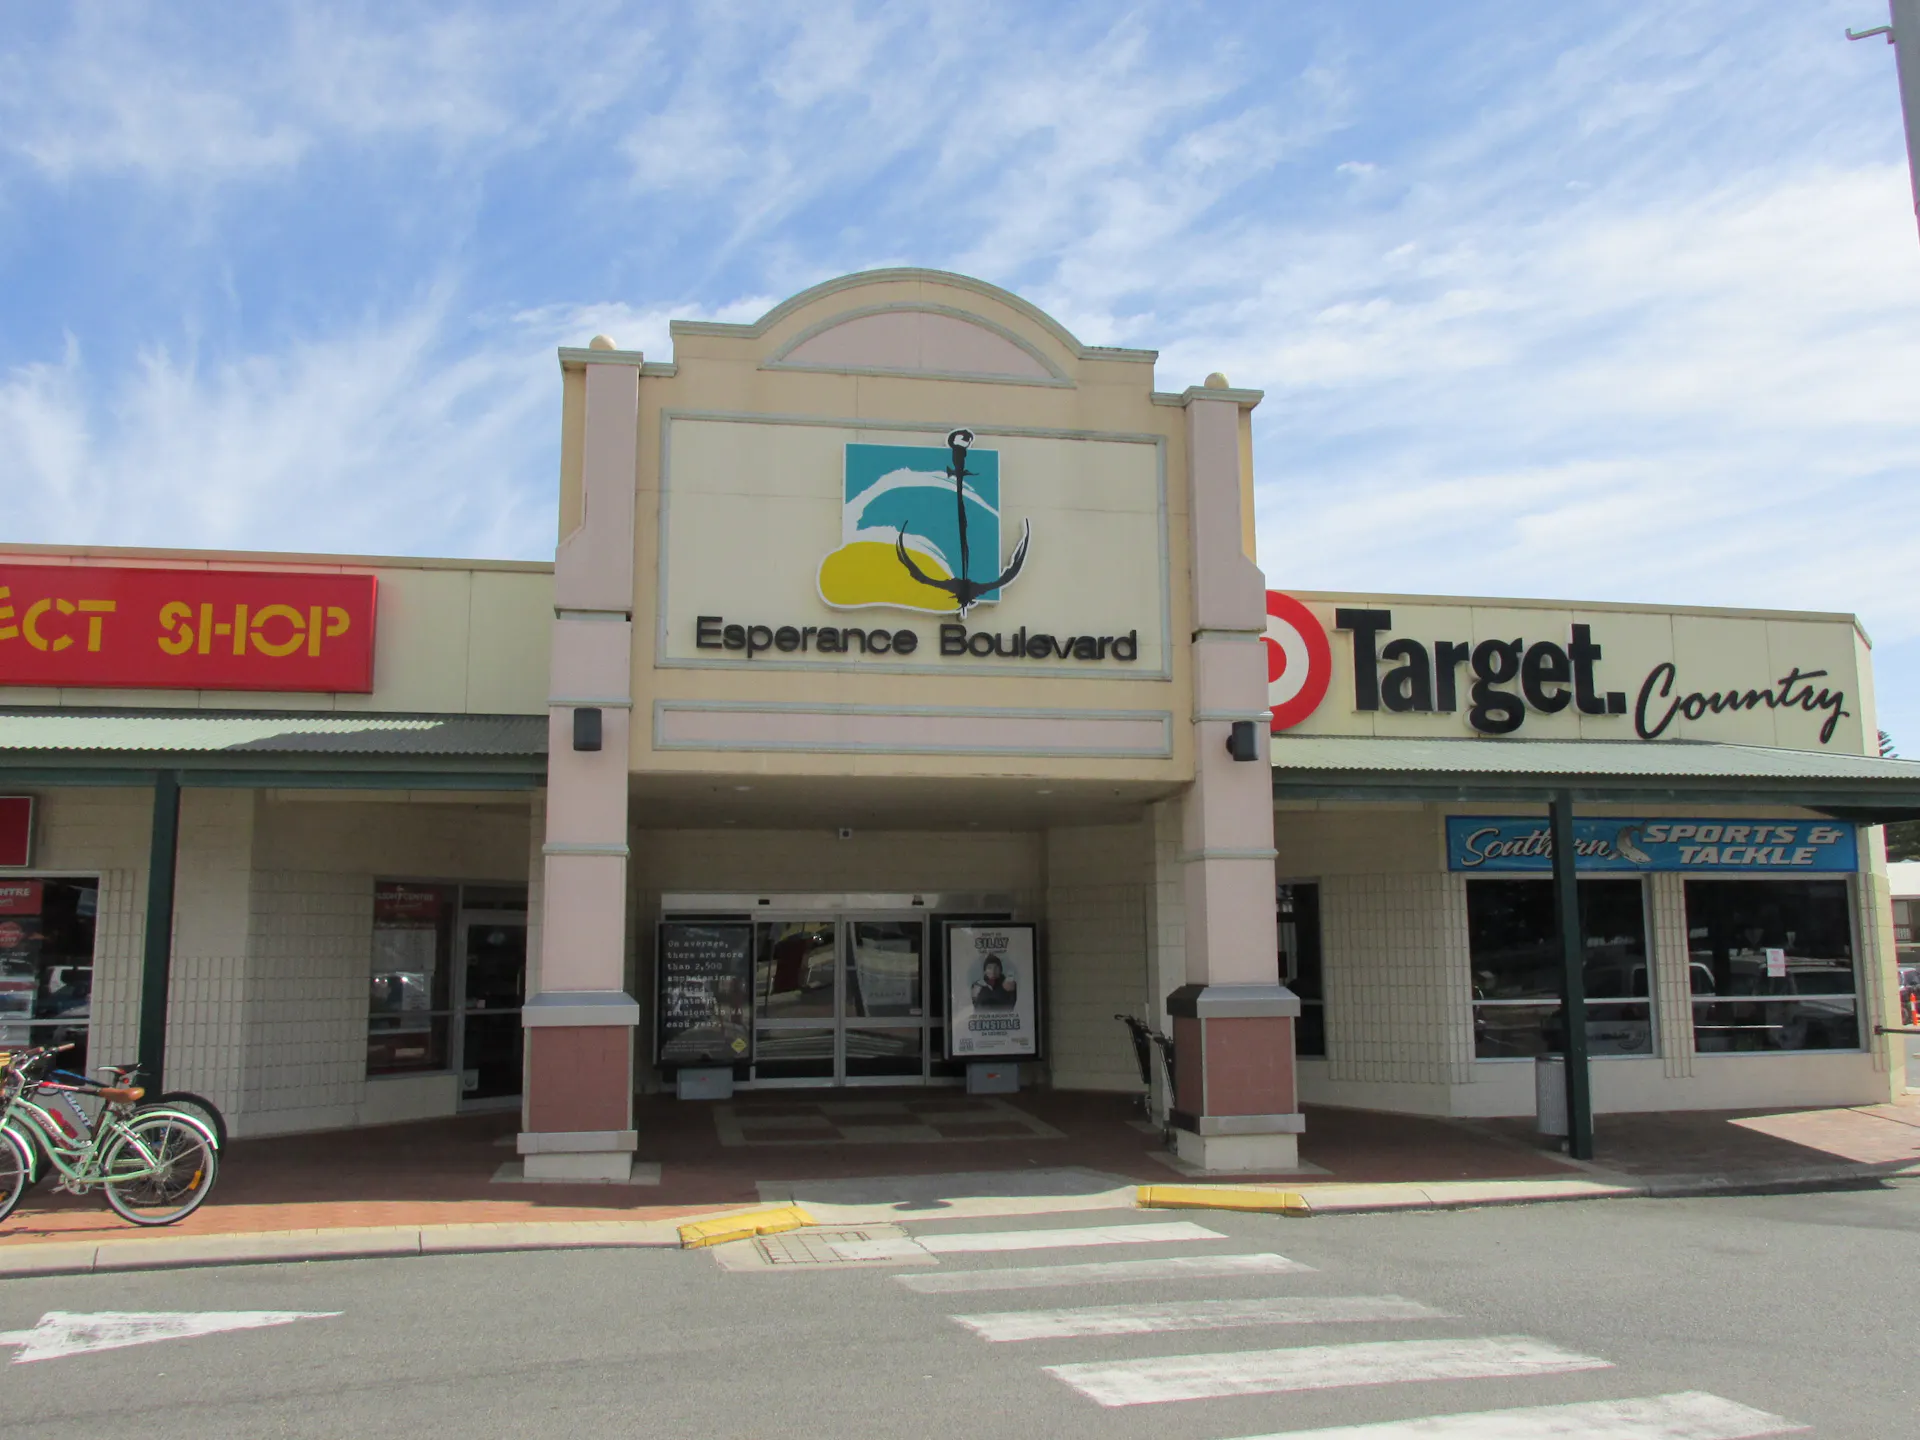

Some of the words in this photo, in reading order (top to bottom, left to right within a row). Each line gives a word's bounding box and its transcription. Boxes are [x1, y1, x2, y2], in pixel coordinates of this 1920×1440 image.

[158, 601, 351, 657] SHOP
[696, 616, 918, 658] Esperance
[939, 623, 1138, 661] Boulevard
[1635, 662, 1850, 744] Country
[1643, 825, 1798, 844] SPORTS
[1808, 826, 1843, 844] &
[1461, 828, 1610, 866] Southrn
[1680, 846, 1818, 865] TACKLE
[667, 940, 680, 948] On
[683, 940, 729, 949] average,
[974, 936, 1010, 949] SILLY
[667, 951, 696, 959] there
[719, 951, 744, 959] more
[694, 963, 723, 972] 2,500
[666, 1020, 691, 1028] each
[694, 1021, 723, 1029] year.
[968, 1018, 1021, 1031] SENSIBLE
[62, 1089, 93, 1127] GIANT
